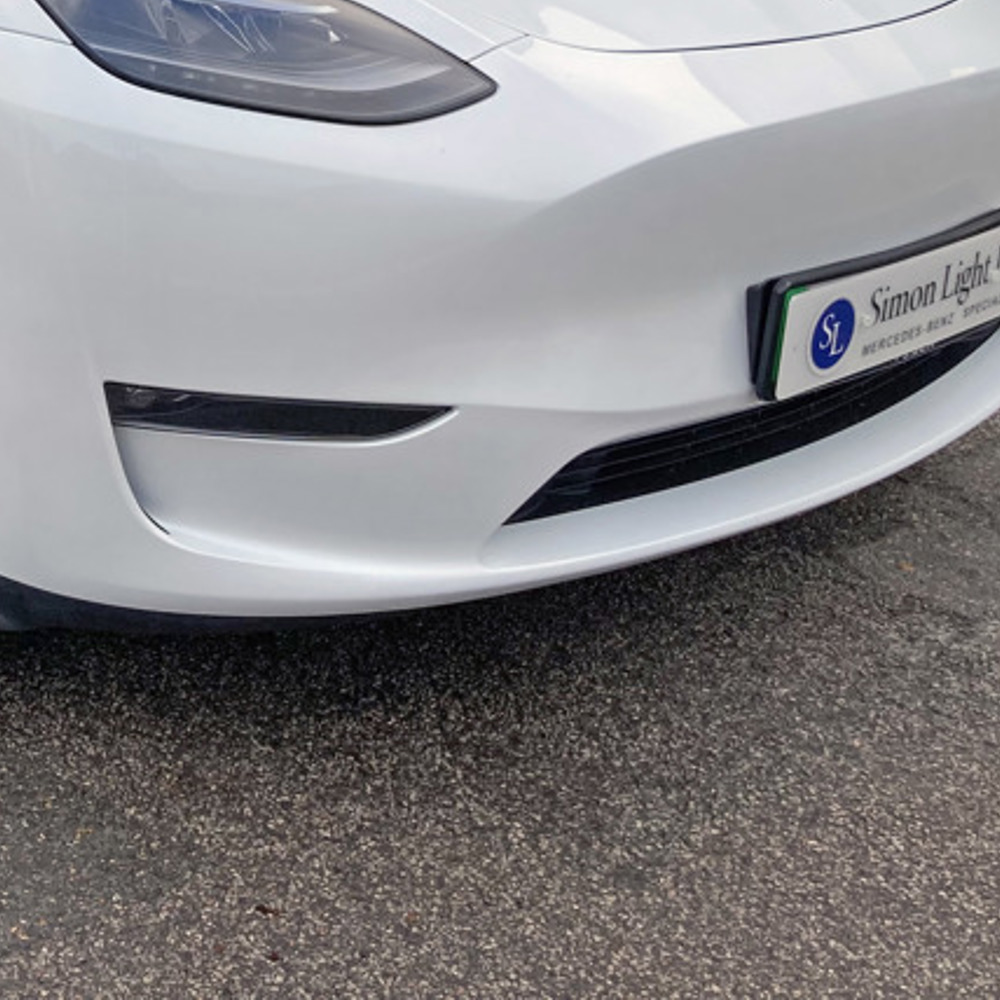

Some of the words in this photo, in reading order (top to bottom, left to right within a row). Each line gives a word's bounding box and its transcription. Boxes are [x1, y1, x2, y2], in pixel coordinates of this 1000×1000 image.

[870, 284, 937, 327] Simon
[940, 251, 992, 306] Light
[818, 313, 844, 357] SL
